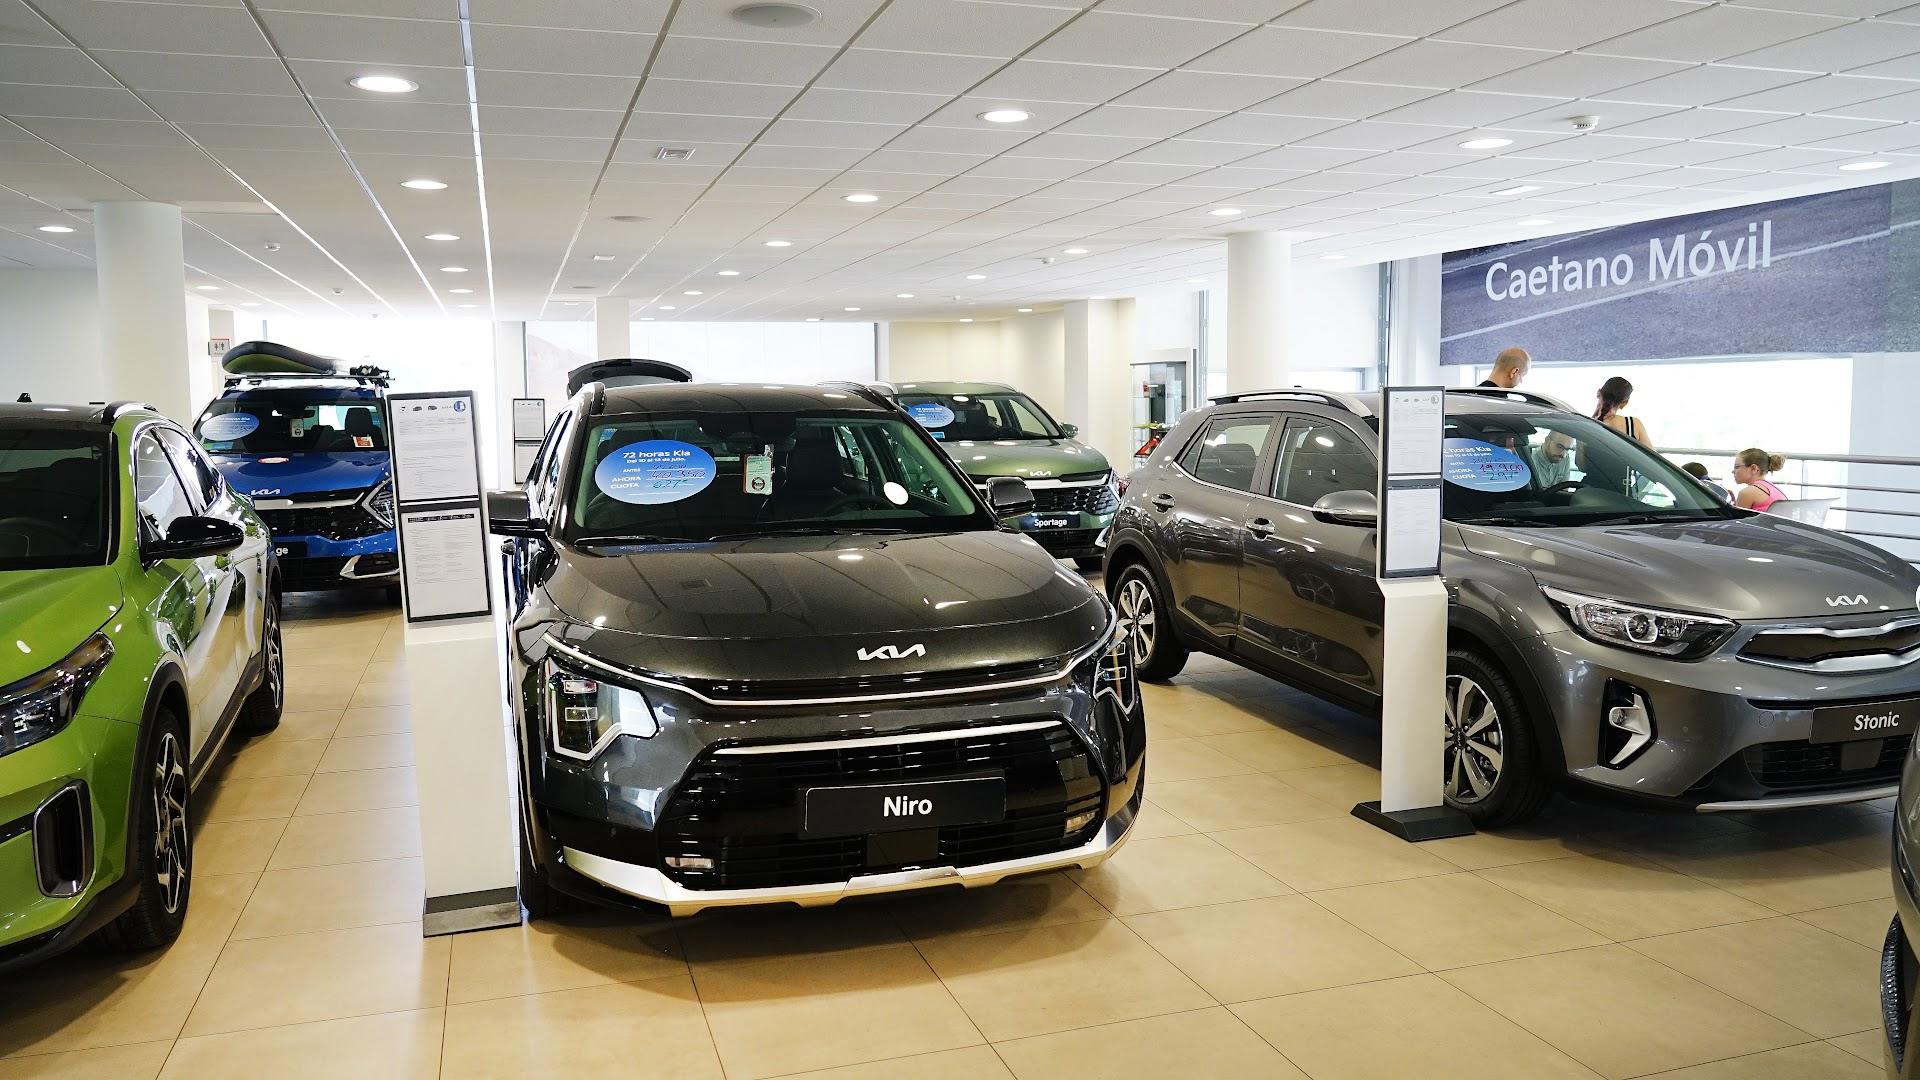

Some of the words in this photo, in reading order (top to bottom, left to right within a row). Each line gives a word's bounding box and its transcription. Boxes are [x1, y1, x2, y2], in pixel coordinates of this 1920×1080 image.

[1485, 253, 1634, 301] Caetano
[1649, 220, 1772, 282] Móvil
[1034, 518, 1068, 528] Sportage
[275, 547, 289, 556] ge
[1825, 594, 1869, 607] KIA
[856, 643, 927, 661] KIA
[1854, 711, 1900, 731] Stonic
[883, 795, 933, 817] Niro
